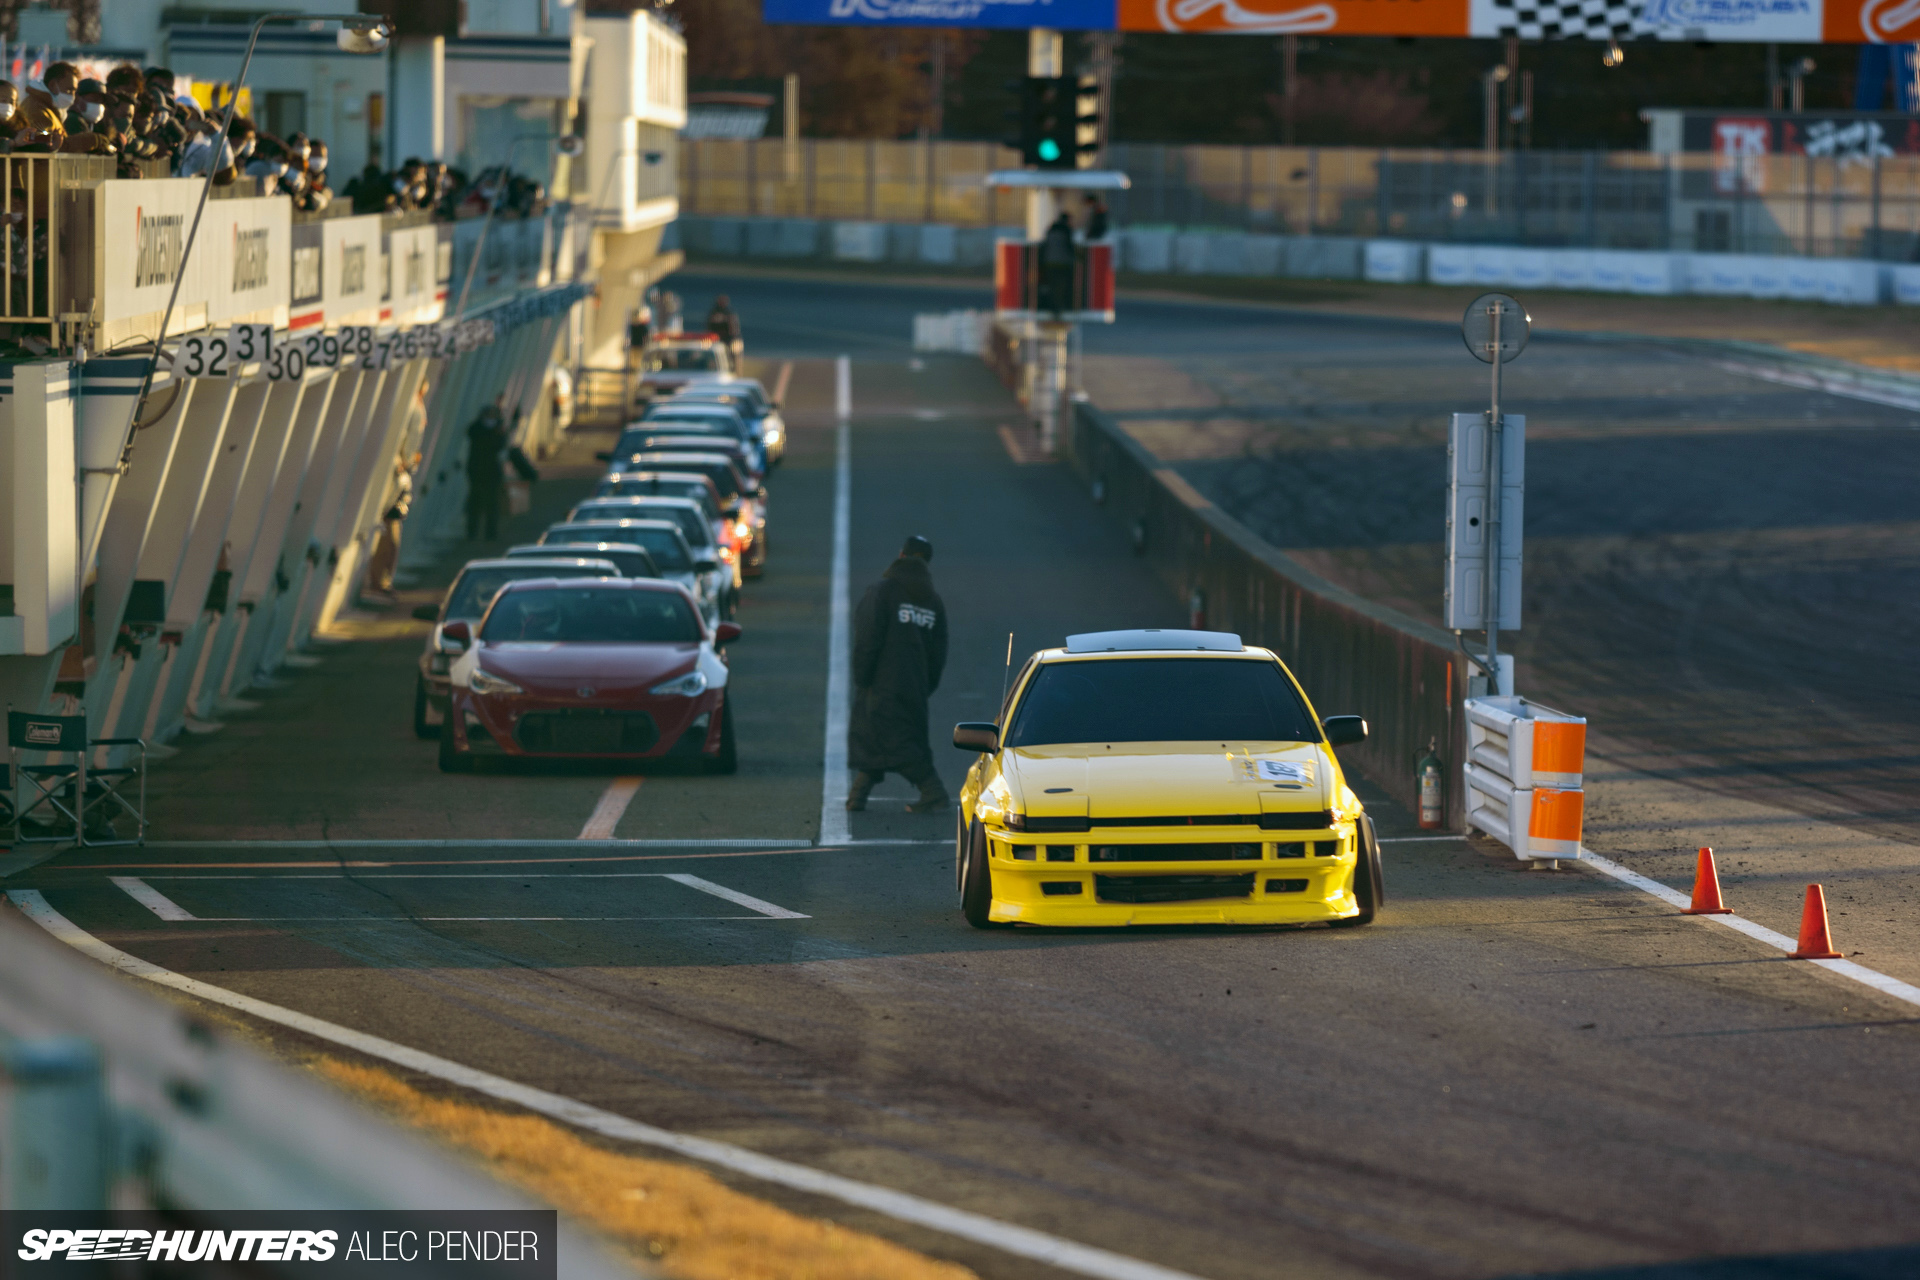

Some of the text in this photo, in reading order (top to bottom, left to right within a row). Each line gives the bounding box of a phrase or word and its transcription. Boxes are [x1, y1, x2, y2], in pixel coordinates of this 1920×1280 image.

[184, 337, 228, 377] 32
[236, 325, 272, 361] 31
[305, 335, 339, 367] 29
[340, 325, 373, 356] 28
[391, 332, 418, 359] 26
[267, 347, 304, 382] 30
